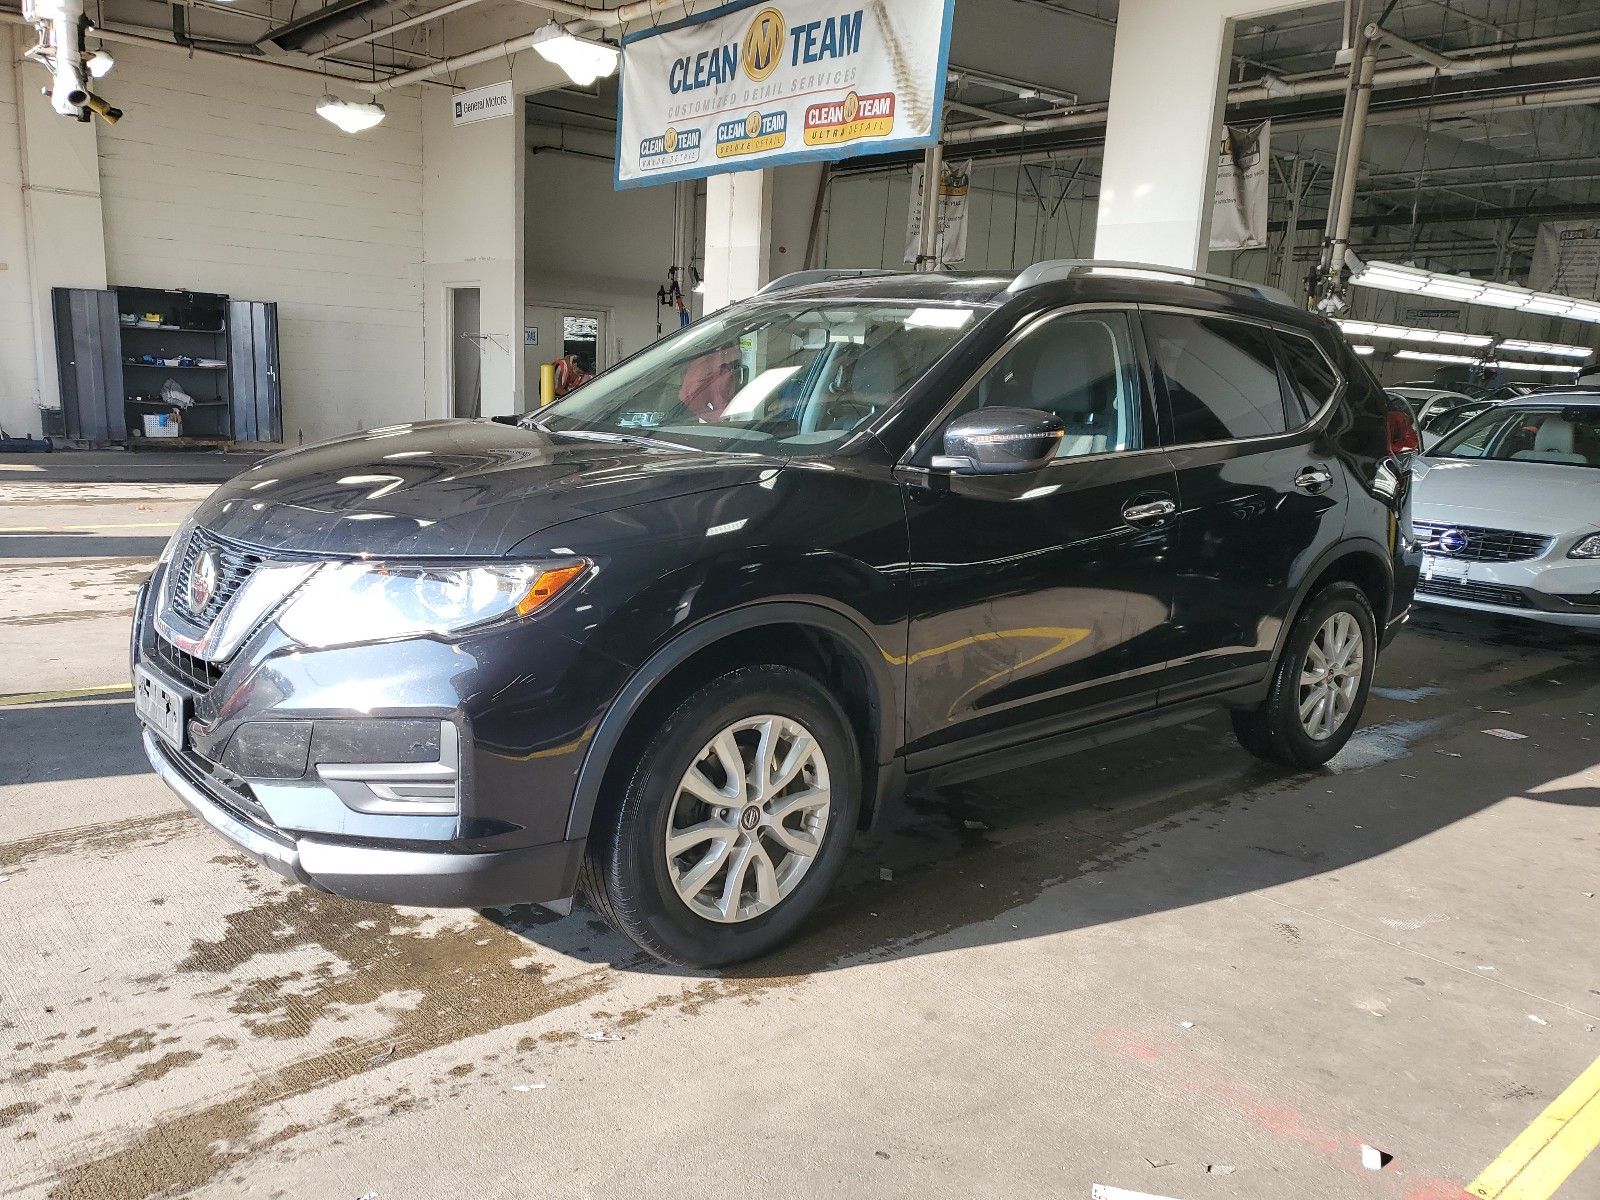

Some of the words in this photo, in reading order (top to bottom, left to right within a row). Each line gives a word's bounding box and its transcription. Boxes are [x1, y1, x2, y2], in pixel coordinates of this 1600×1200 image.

[669, 42, 738, 95] CLEAN
[789, 9, 864, 67] TEAM
[464, 98, 485, 114] General
[486, 95, 507, 108] Motors
[667, 92, 737, 118] CUSTOMIZED
[743, 83, 784, 102] DETAIL
[790, 67, 857, 93] SERVICES
[808, 105, 844, 126] CLEAN
[859, 97, 891, 117] TEAM
[718, 121, 745, 141] CLEAN
[762, 113, 785, 134] TEAM
[811, 128, 846, 140] ULTRA
[848, 120, 884, 135] DETAIL
[641, 137, 664, 155] CLEAN
[677, 131, 700, 149] TEAM
